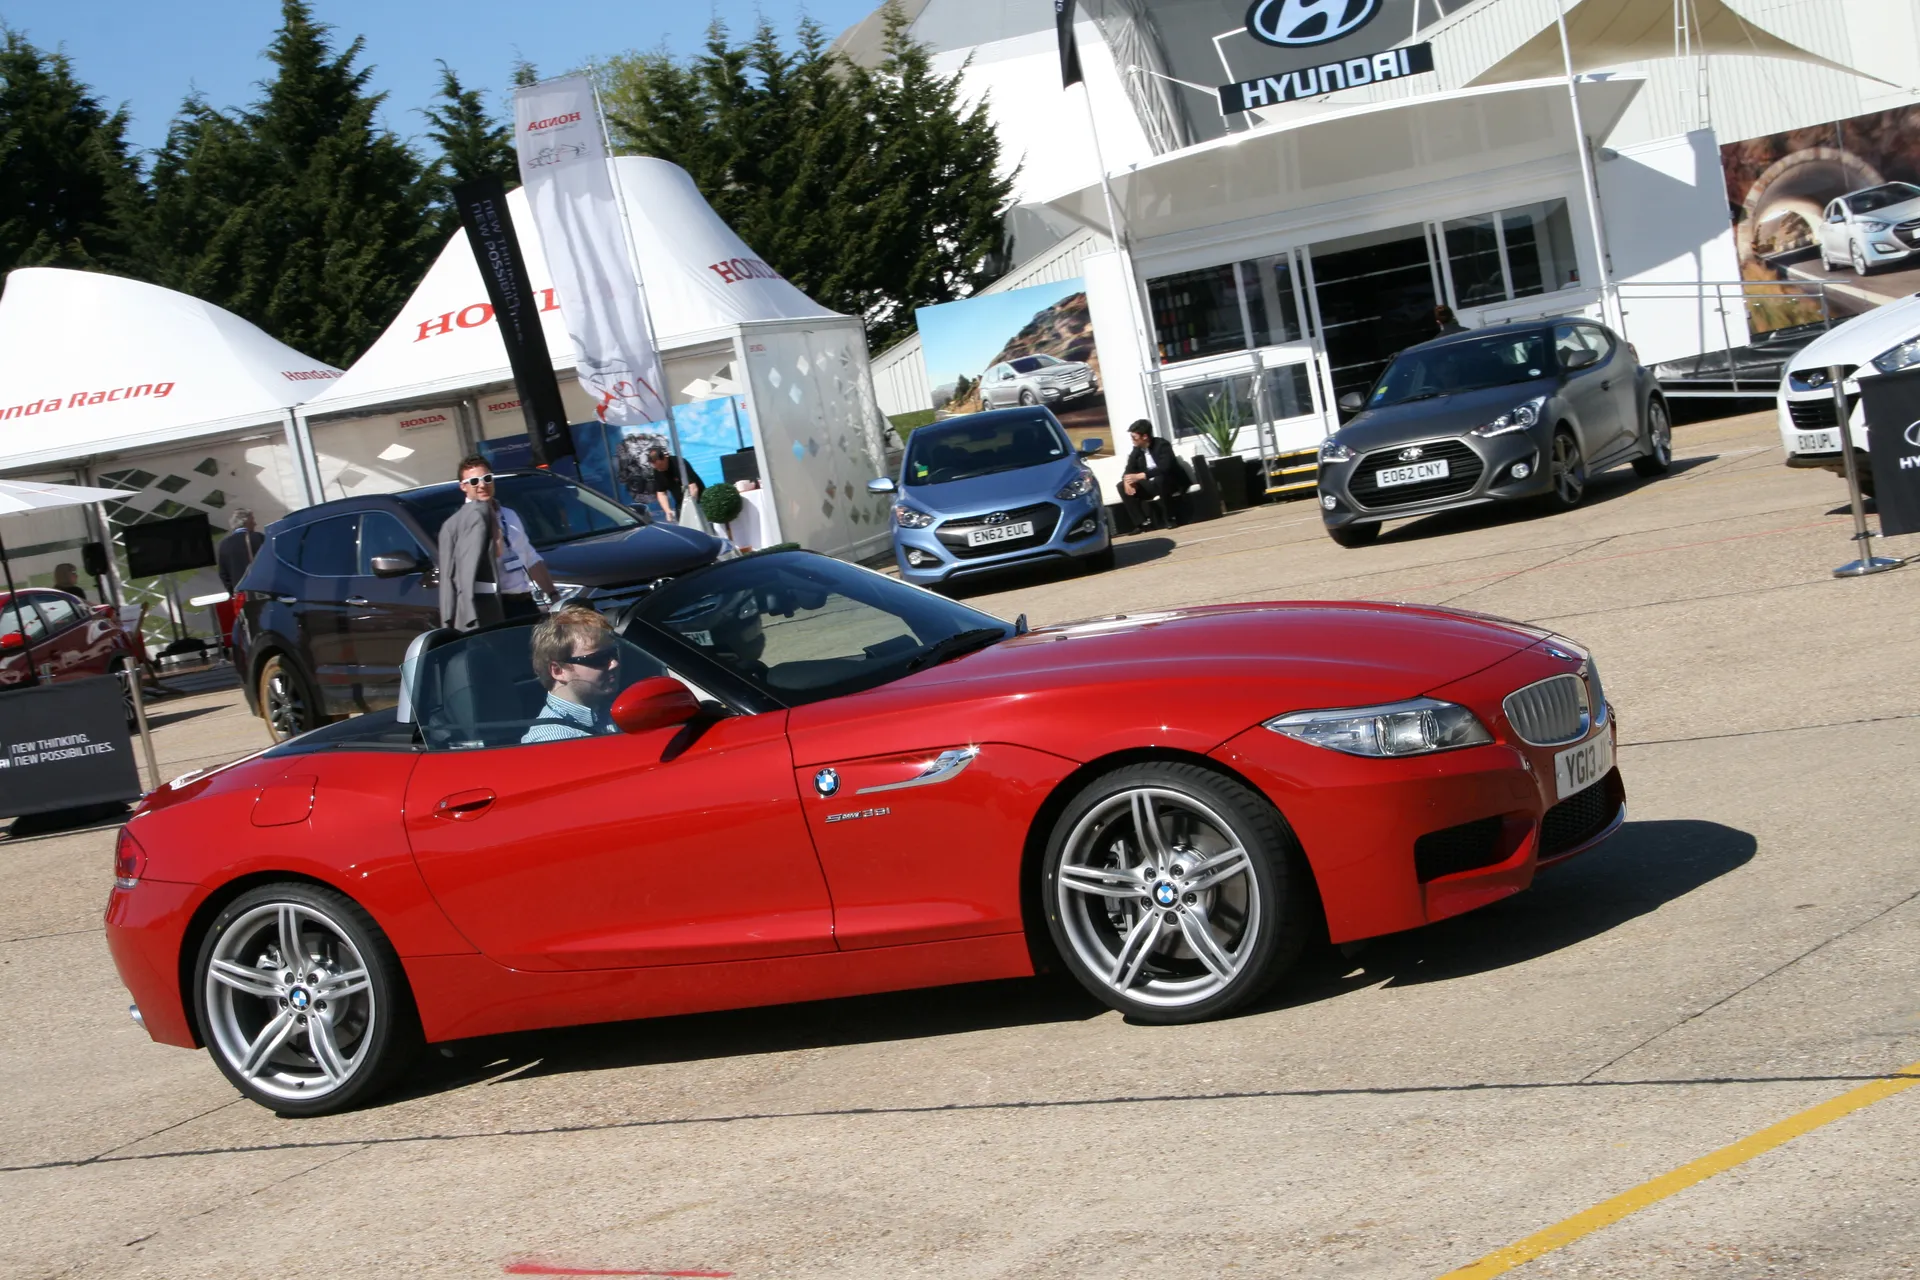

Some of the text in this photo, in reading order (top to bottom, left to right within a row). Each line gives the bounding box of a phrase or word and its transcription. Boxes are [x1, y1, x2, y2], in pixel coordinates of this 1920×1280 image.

[1241, 49, 1411, 108] HYUNDAI
[708, 258, 784, 284] HOND
[281, 370, 333, 382] Honda
[0, 382, 175, 420] nda Racing
[400, 414, 447, 429] HONDA
[1418, 462, 1441, 478] CNY
[974, 523, 1029, 543] EN62 EUC
[11, 734, 90, 754] NEW THINKING.
[14, 741, 116, 767] NEW POSSIBILITIES.
[1565, 744, 1596, 789] YG13
